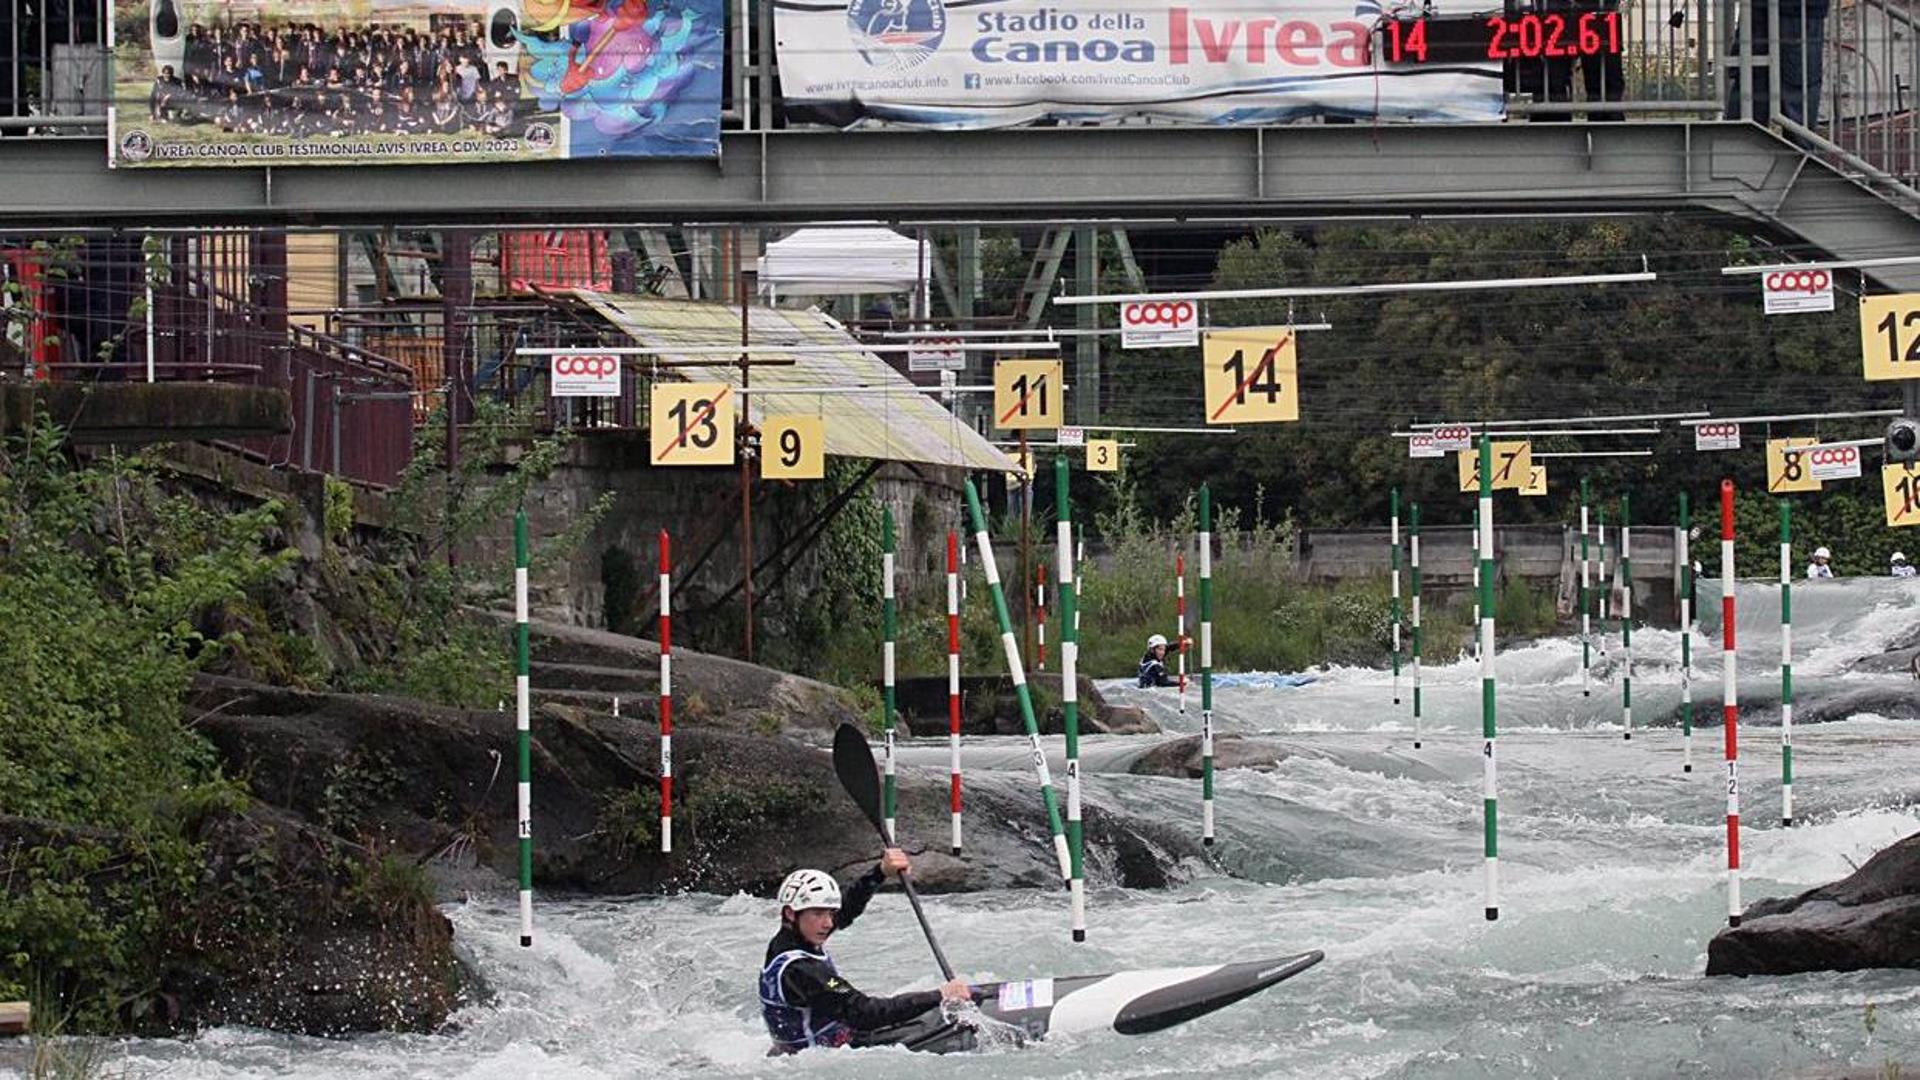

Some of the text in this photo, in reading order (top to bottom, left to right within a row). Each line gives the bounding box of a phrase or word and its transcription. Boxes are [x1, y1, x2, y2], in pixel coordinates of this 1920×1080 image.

[977, 8, 1145, 33] Stadio della
[971, 37, 1155, 63] Canoa
[1168, 7, 1372, 67] Ivrea
[1386, 13, 1618, 62] 14 2:02.61
[156, 146, 194, 157] IVREA
[199, 144, 248, 156] CANOA
[252, 144, 284, 155] CLUB
[289, 143, 372, 155] TESTIMONIAL
[376, 142, 406, 154] AVIS
[410, 141, 448, 153] IVREA
[486, 140, 518, 152] 2023
[1767, 270, 1829, 295] coop
[1125, 301, 1193, 328] coop
[556, 356, 617, 379] coop
[1223, 348, 1282, 405] 14
[1011, 374, 1047, 416] 11
[668, 399, 718, 449] 13
[1698, 424, 1737, 438] coop
[779, 429, 802, 467] 9
[1097, 446, 1108, 465] 3
[1811, 447, 1857, 466] coop
[1500, 453, 1516, 480] 7
[1784, 451, 1802, 481] 8
[1484, 741, 1492, 758] 4
[1068, 762, 1076, 779] 4
[1728, 762, 1737, 795] 12
